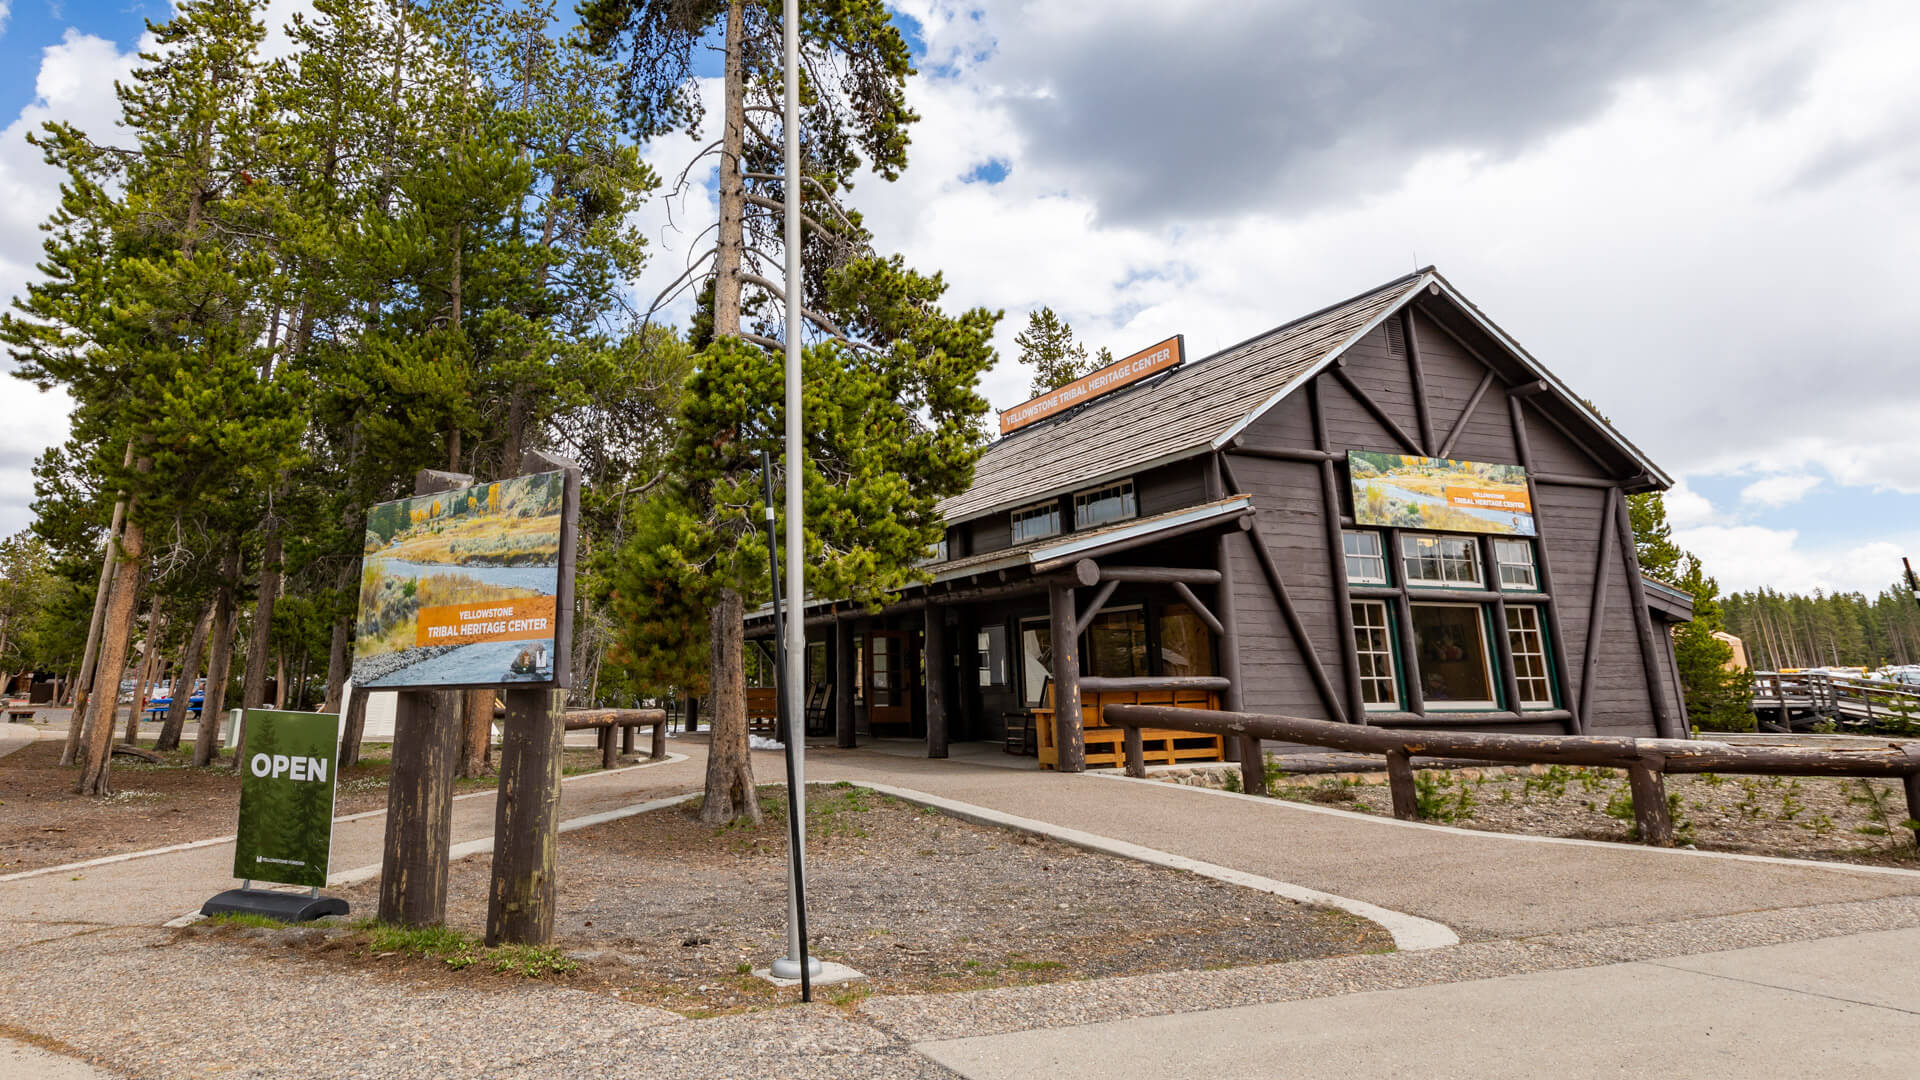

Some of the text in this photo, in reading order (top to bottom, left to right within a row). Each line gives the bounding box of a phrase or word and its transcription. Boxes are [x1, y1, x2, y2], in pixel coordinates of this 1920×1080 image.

[1005, 348, 1171, 425] YELLOWSTONE TRIBAL HERITAGE CENTER
[459, 607, 514, 621] YELLOWSTONE
[428, 618, 547, 638] TRIBAL HERITAGE CENTER
[251, 752, 328, 783] OPEN
